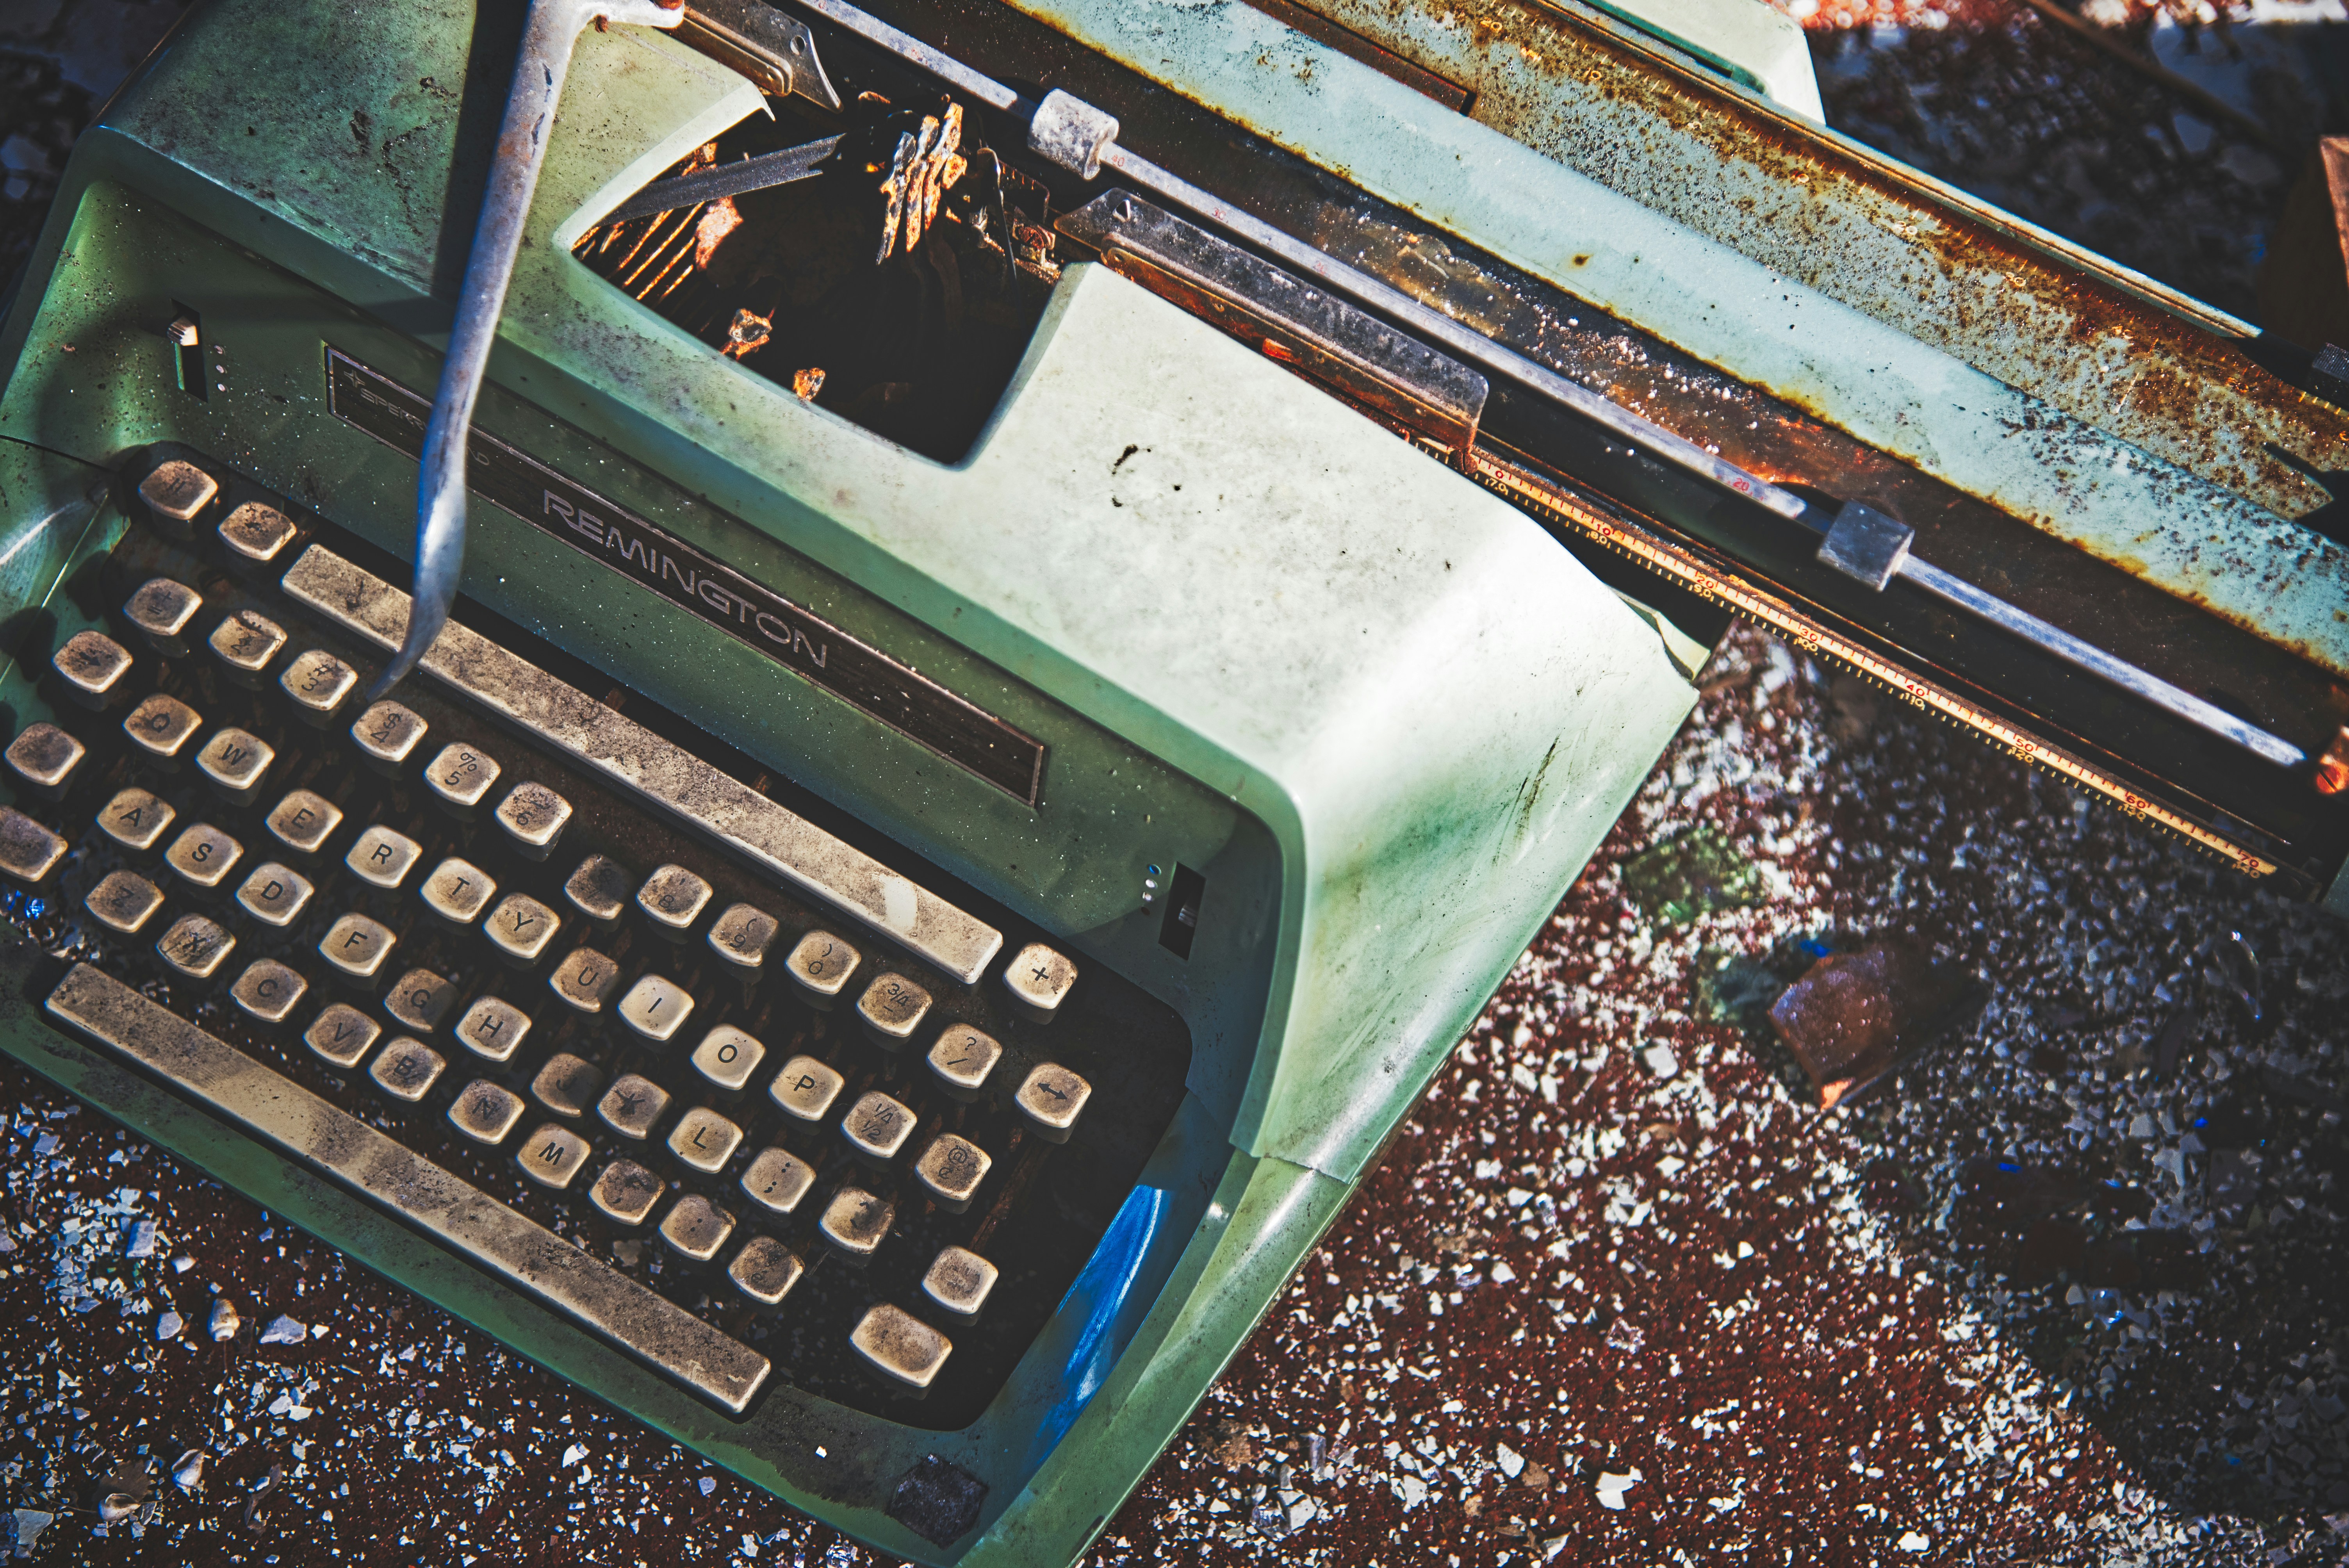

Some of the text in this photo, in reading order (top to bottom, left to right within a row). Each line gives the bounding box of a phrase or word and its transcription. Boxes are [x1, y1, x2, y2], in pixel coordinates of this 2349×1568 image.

[1733, 477, 1750, 491] 20
[544, 489, 827, 668] REMINGTON
[1495, 470, 2260, 868] 0 10 20 30 40 50 60 70
[301, 677, 319, 692] 3
[151, 713, 170, 733] Q
[383, 713, 401, 729] $
[1798, 636, 1819, 652] 100
[1905, 692, 1924, 707] 110
[2012, 747, 2035, 764] 120
[2124, 804, 2146, 821] 130
[371, 731, 390, 743] 4
[222, 743, 247, 766] W
[460, 752, 478, 772] %
[445, 771, 461, 786] 5
[120, 807, 143, 828] A
[291, 808, 315, 829] E
[516, 811, 534, 825] 6
[191, 843, 213, 862] S
[371, 843, 393, 864] R
[261, 880, 284, 901] D
[452, 876, 470, 895] T
[112, 887, 135, 909] Z
[658, 894, 675, 909] 8
[513, 911, 534, 932] Y
[746, 918, 757, 932] (
[344, 931, 368, 948] F
[729, 934, 747, 948] 9
[822, 943, 832, 957] )
[577, 966, 598, 987] U
[257, 979, 278, 997] C
[410, 989, 431, 1010] G
[334, 1022, 355, 1042] V
[478, 1015, 504, 1038] H
[964, 1036, 977, 1051] ?
[717, 1044, 738, 1064] O
[394, 1055, 416, 1076] B
[556, 1077, 577, 1092] J
[793, 1074, 815, 1092] P
[472, 1098, 497, 1120] N
[692, 1126, 707, 1149] L
[538, 1142, 565, 1166] M
[947, 1146, 968, 1165] @
